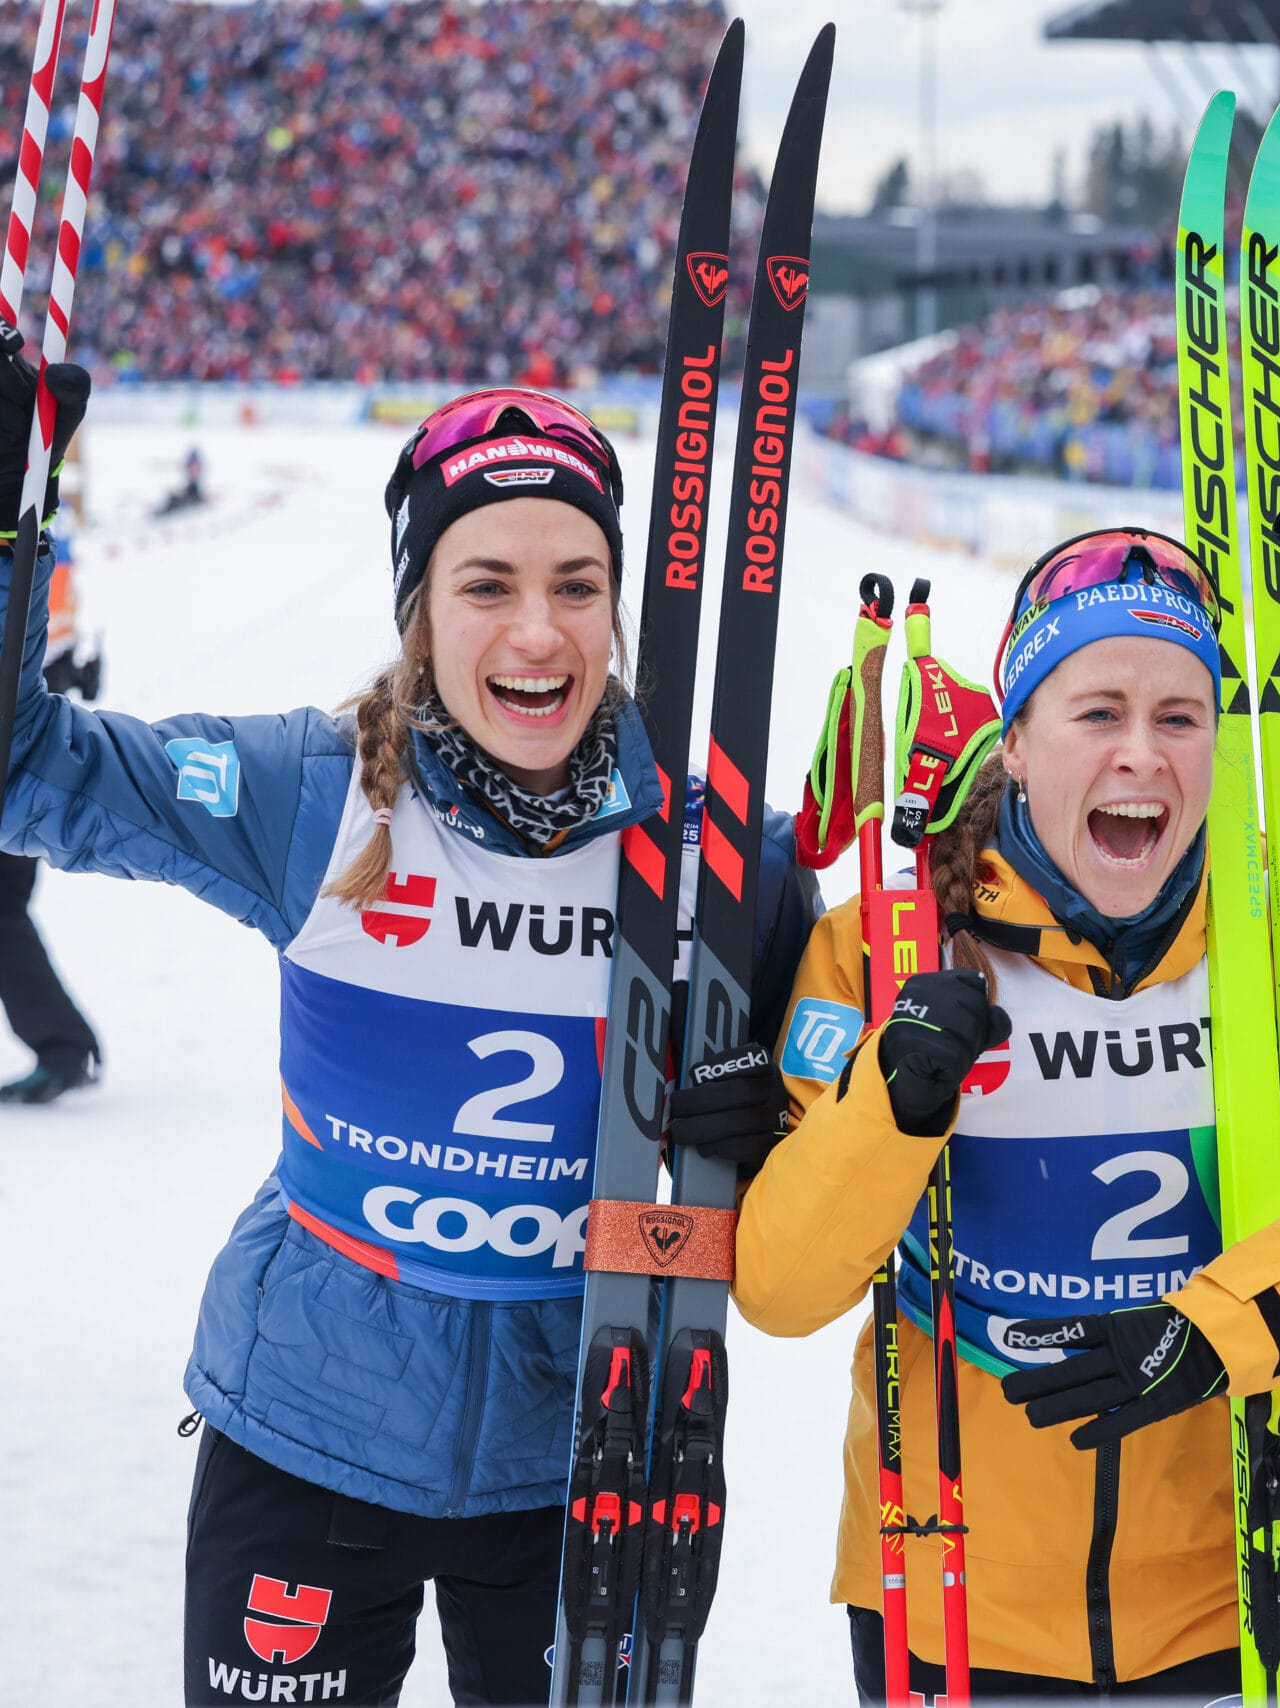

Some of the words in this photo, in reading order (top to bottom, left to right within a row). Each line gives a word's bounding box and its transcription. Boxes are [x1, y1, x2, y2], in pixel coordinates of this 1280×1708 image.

[1185, 231, 1237, 616] FISCHER
[664, 345, 716, 590] ROSSIGNOL
[742, 349, 794, 594] ROSSIGNOL
[925, 663, 960, 738] LEKI
[912, 754, 941, 791] LE
[1244, 820, 1263, 919] SPEEDMAX
[454, 895, 616, 958] WÜR
[452, 1030, 565, 1143] 2
[1028, 1017, 1212, 1081] WÜR
[325, 1113, 589, 1181] TRONDHEIM
[1090, 1150, 1190, 1261] 2
[1139, 1311, 1187, 1379] Roeck
[1234, 1413, 1255, 1636] FISCHER
[208, 1656, 347, 1704] WÜRTH
